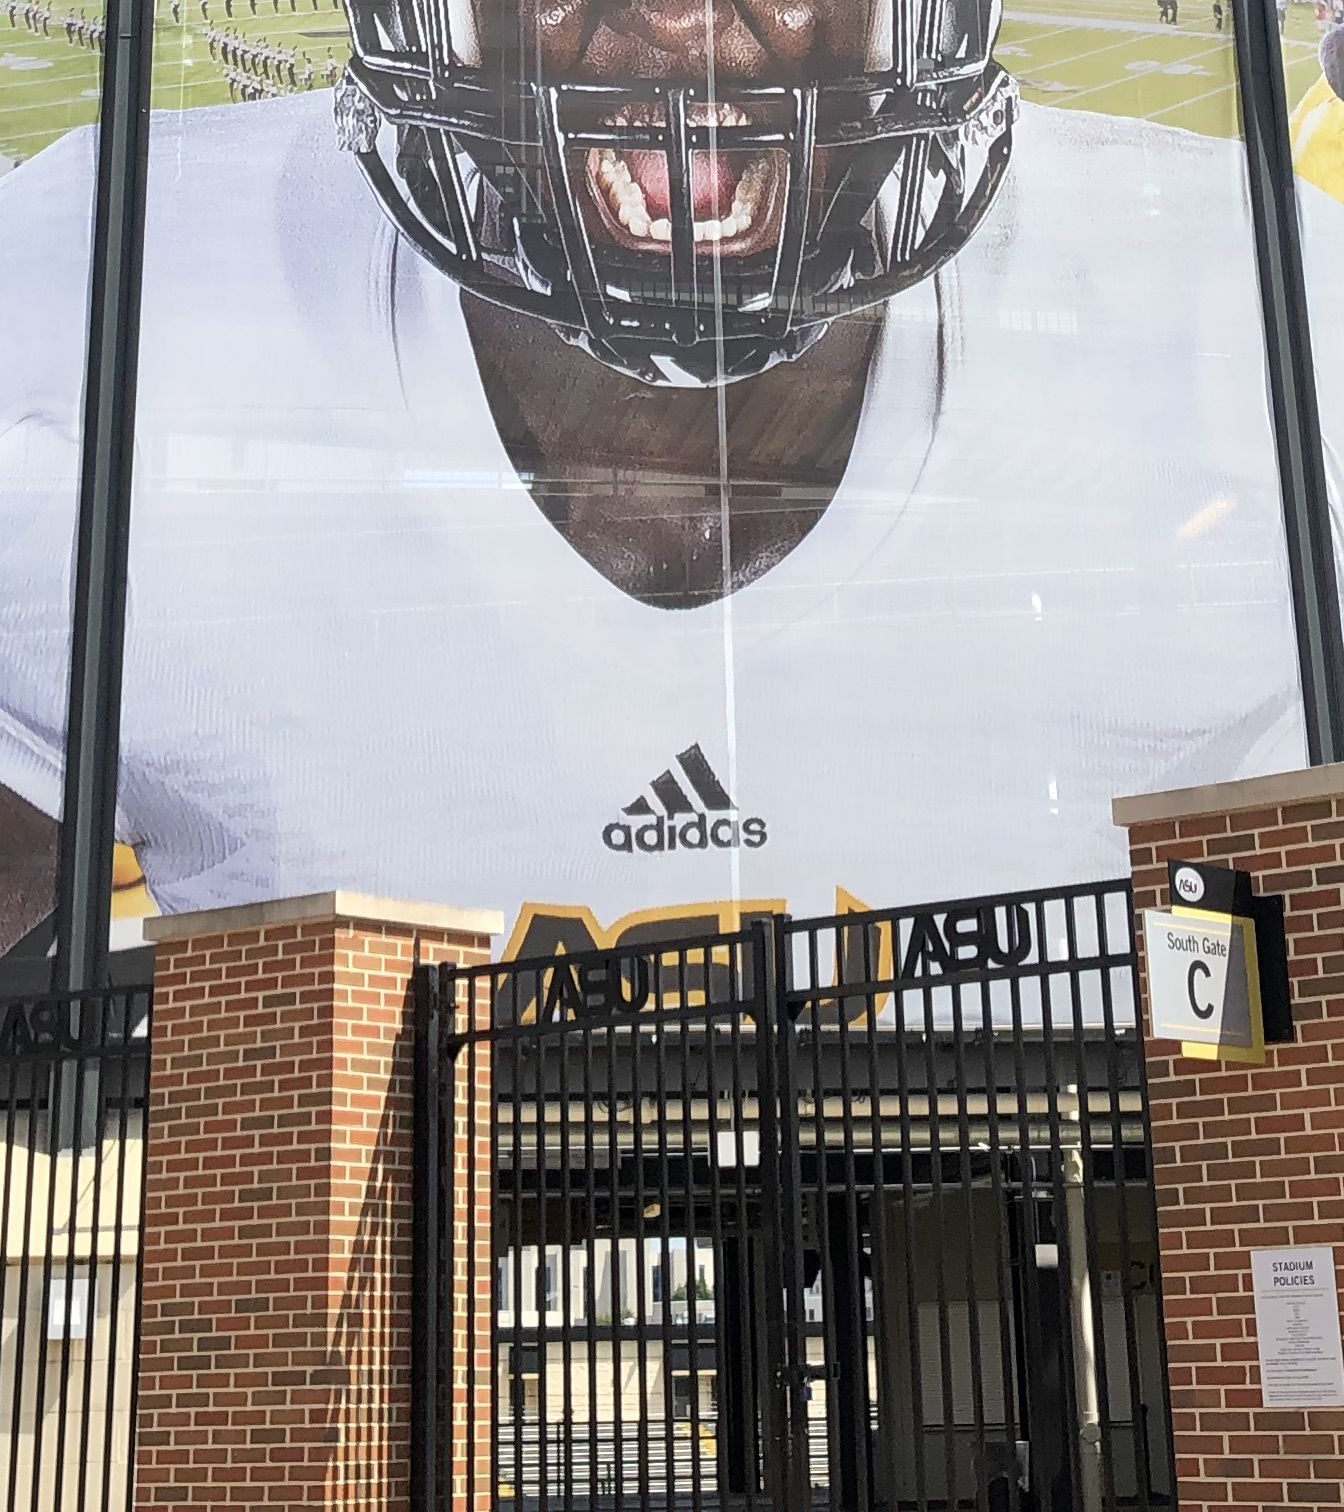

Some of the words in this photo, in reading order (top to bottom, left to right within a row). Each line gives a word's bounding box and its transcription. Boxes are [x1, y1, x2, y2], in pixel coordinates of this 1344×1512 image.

[602, 812, 768, 854] adidas
[1179, 878, 1198, 894] ASU
[903, 902, 1032, 978] ASU
[1167, 932, 1199, 954] South
[1202, 936, 1227, 958] Gate
[544, 954, 649, 1024] ASU
[1188, 960, 1215, 1020] C
[1272, 1260, 1314, 1272] STADIUM
[1273, 1275, 1315, 1287] POLICIES
